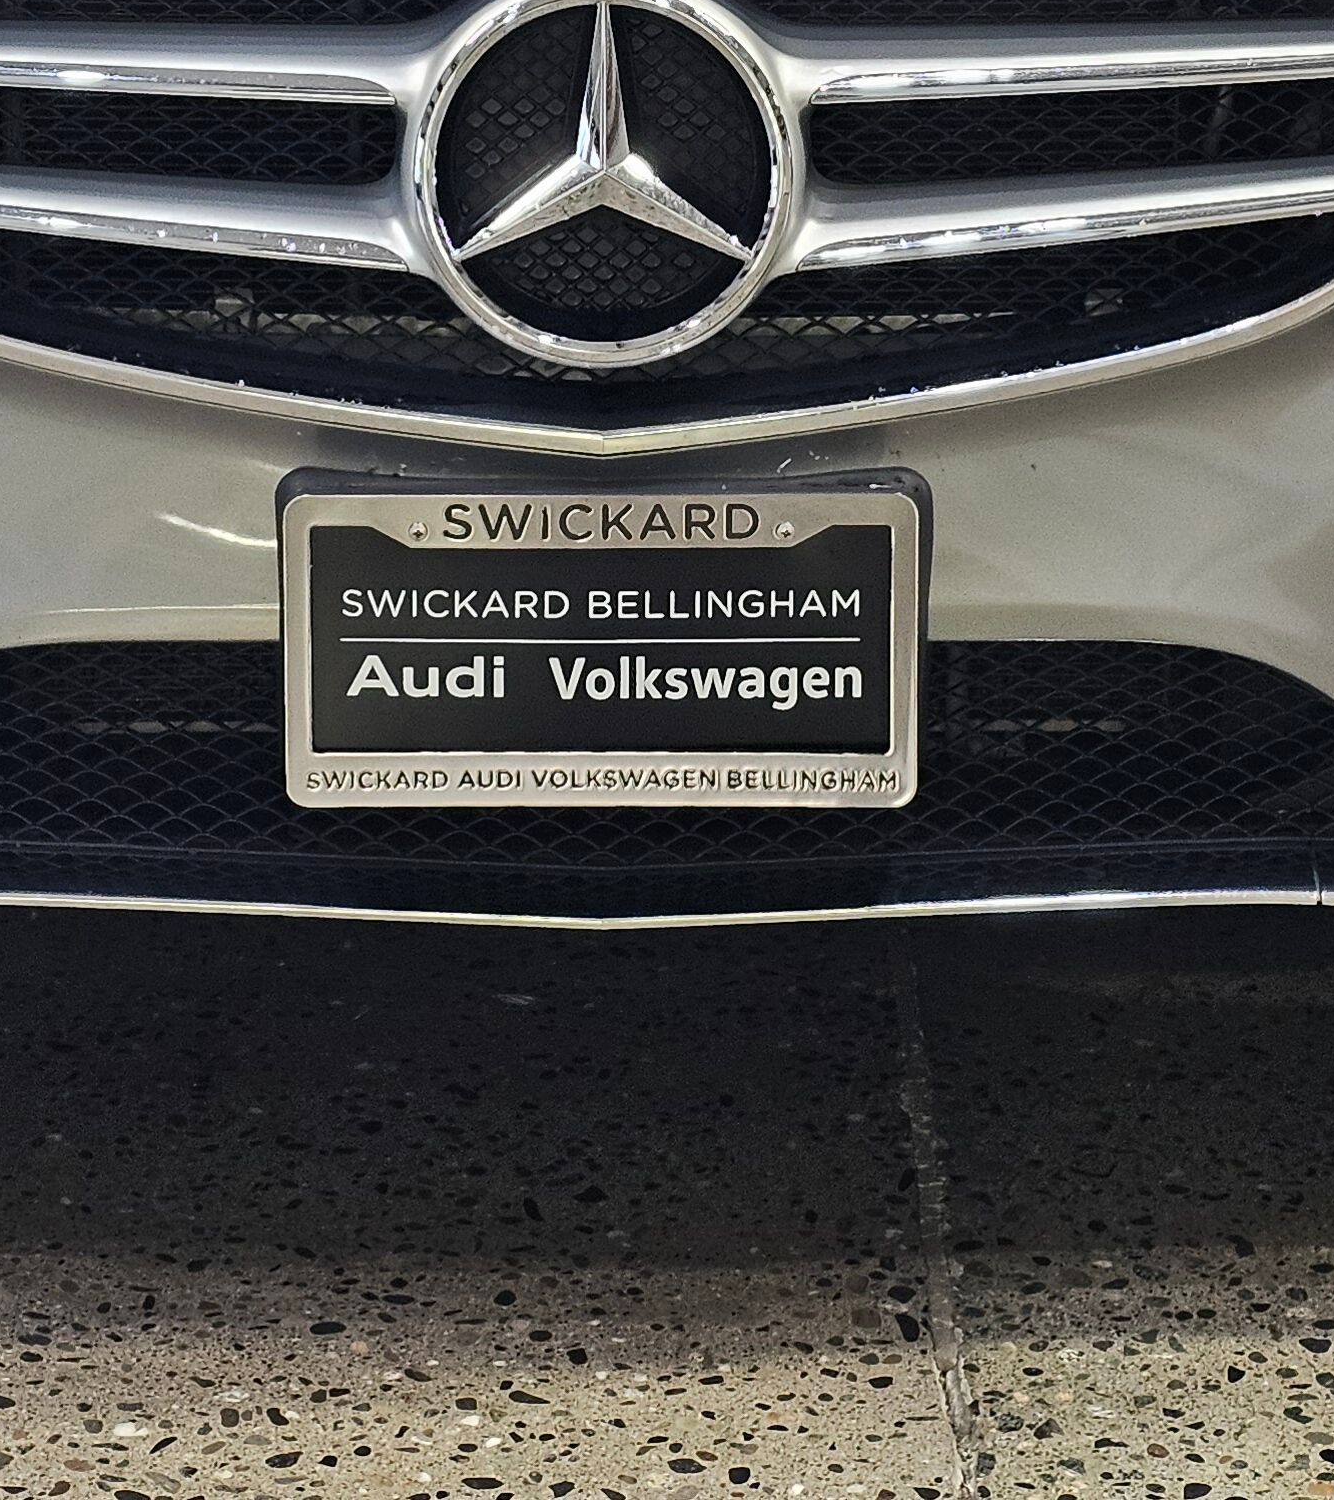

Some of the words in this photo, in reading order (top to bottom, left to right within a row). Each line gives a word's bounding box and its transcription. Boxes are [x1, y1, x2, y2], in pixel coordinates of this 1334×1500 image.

[443, 503, 760, 541] SWICKARD
[341, 588, 570, 619] SWICKARD
[588, 589, 861, 619] BELLINGHAM
[346, 654, 505, 698] Audi
[548, 655, 863, 711] Volkswagen
[306, 769, 450, 792] SWICKARD
[457, 769, 523, 791] AUDI
[531, 769, 717, 791] VOLKSWAGEN
[725, 769, 900, 793] BELLINGHAM
